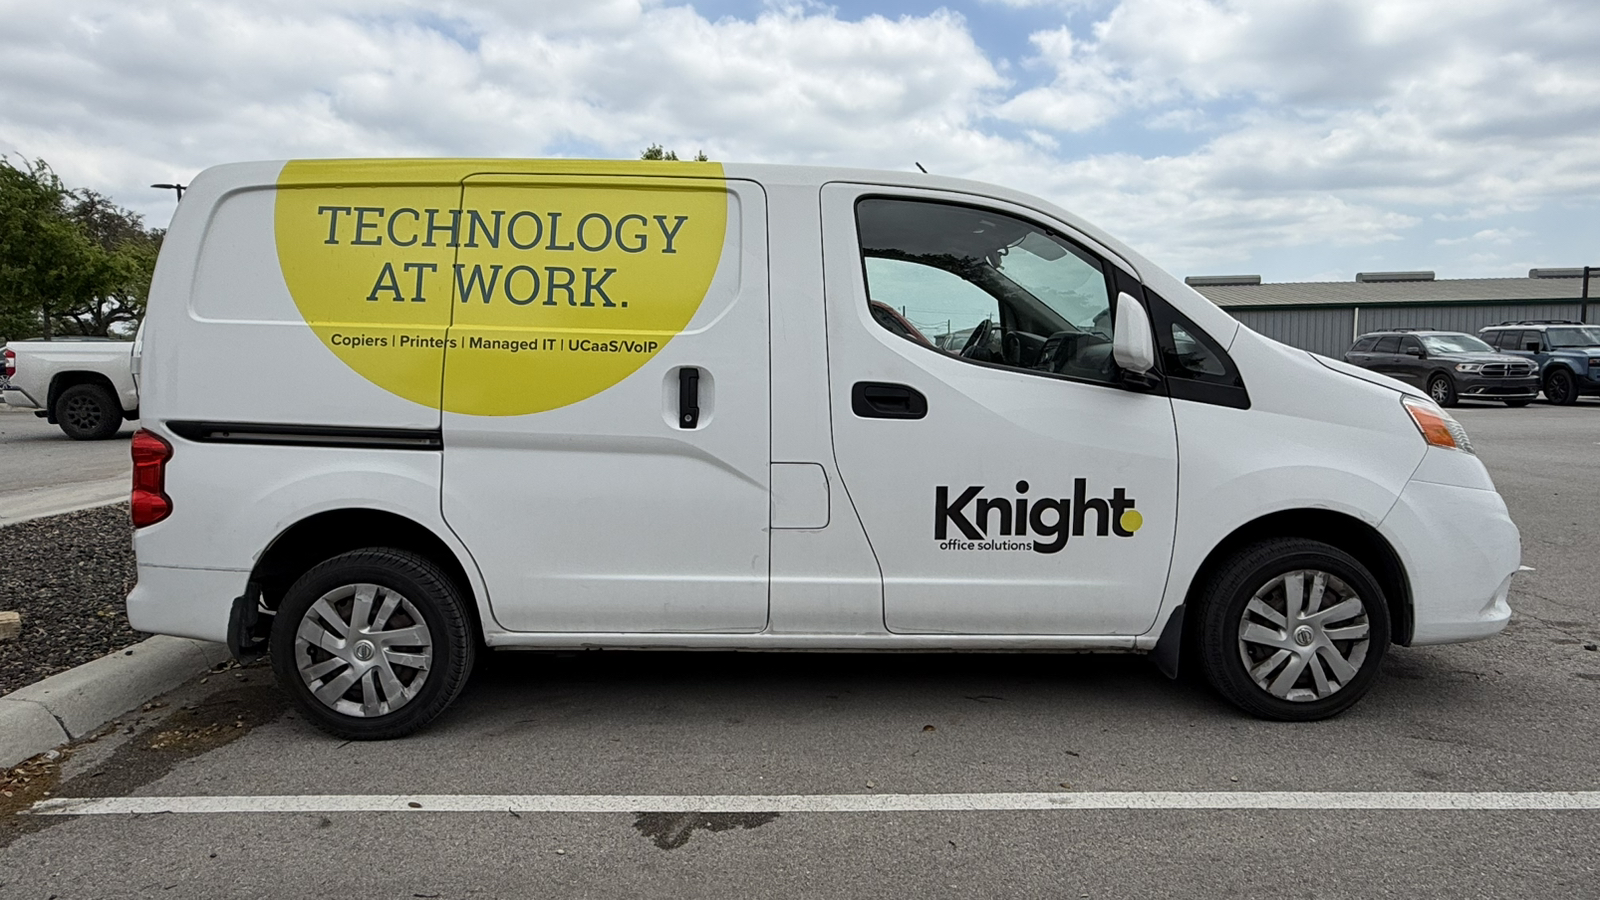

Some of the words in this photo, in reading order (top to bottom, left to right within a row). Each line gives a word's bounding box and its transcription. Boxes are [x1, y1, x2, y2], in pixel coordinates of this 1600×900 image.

[318, 206, 688, 254] TECHNOLOGY
[366, 262, 437, 302] AT
[453, 264, 628, 308] WORK.
[331, 333, 388, 349] Copiers
[400, 335, 457, 349] Printers
[469, 336, 538, 352] Managed
[542, 338, 557, 350] IT
[568, 339, 658, 353] UCaaS/VoIP
[934, 478, 1135, 554] Knight
[939, 539, 975, 551] office
[977, 539, 1032, 551] solutions
